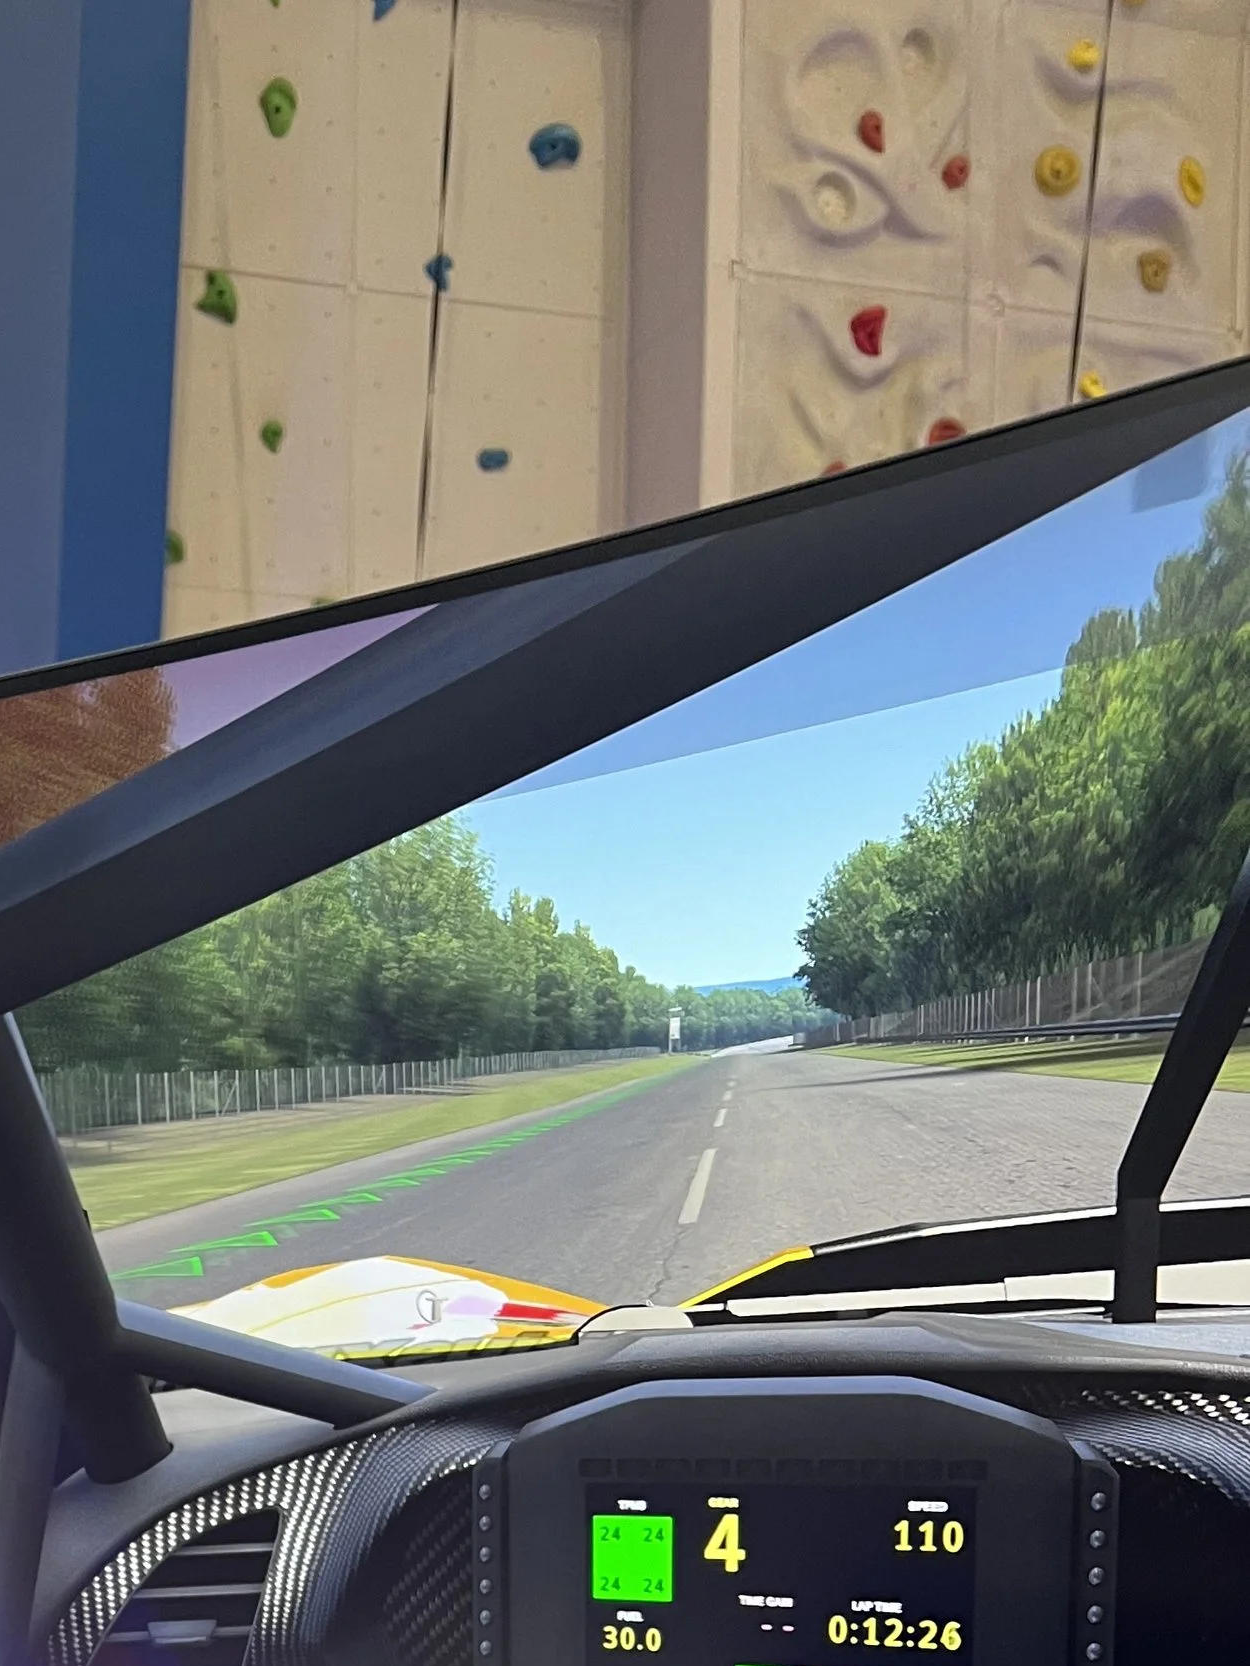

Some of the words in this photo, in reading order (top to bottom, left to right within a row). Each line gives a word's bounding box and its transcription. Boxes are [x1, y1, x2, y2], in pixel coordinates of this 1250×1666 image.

[600, 1526, 621, 1542] 24
[643, 1527, 665, 1542] 24
[704, 1513, 746, 1573] 4
[894, 1519, 964, 1552] 110
[600, 1576, 621, 1592] 24
[643, 1578, 664, 1593] 24
[602, 1625, 662, 1652] 30.0
[828, 1615, 962, 1651] 0:12:26
